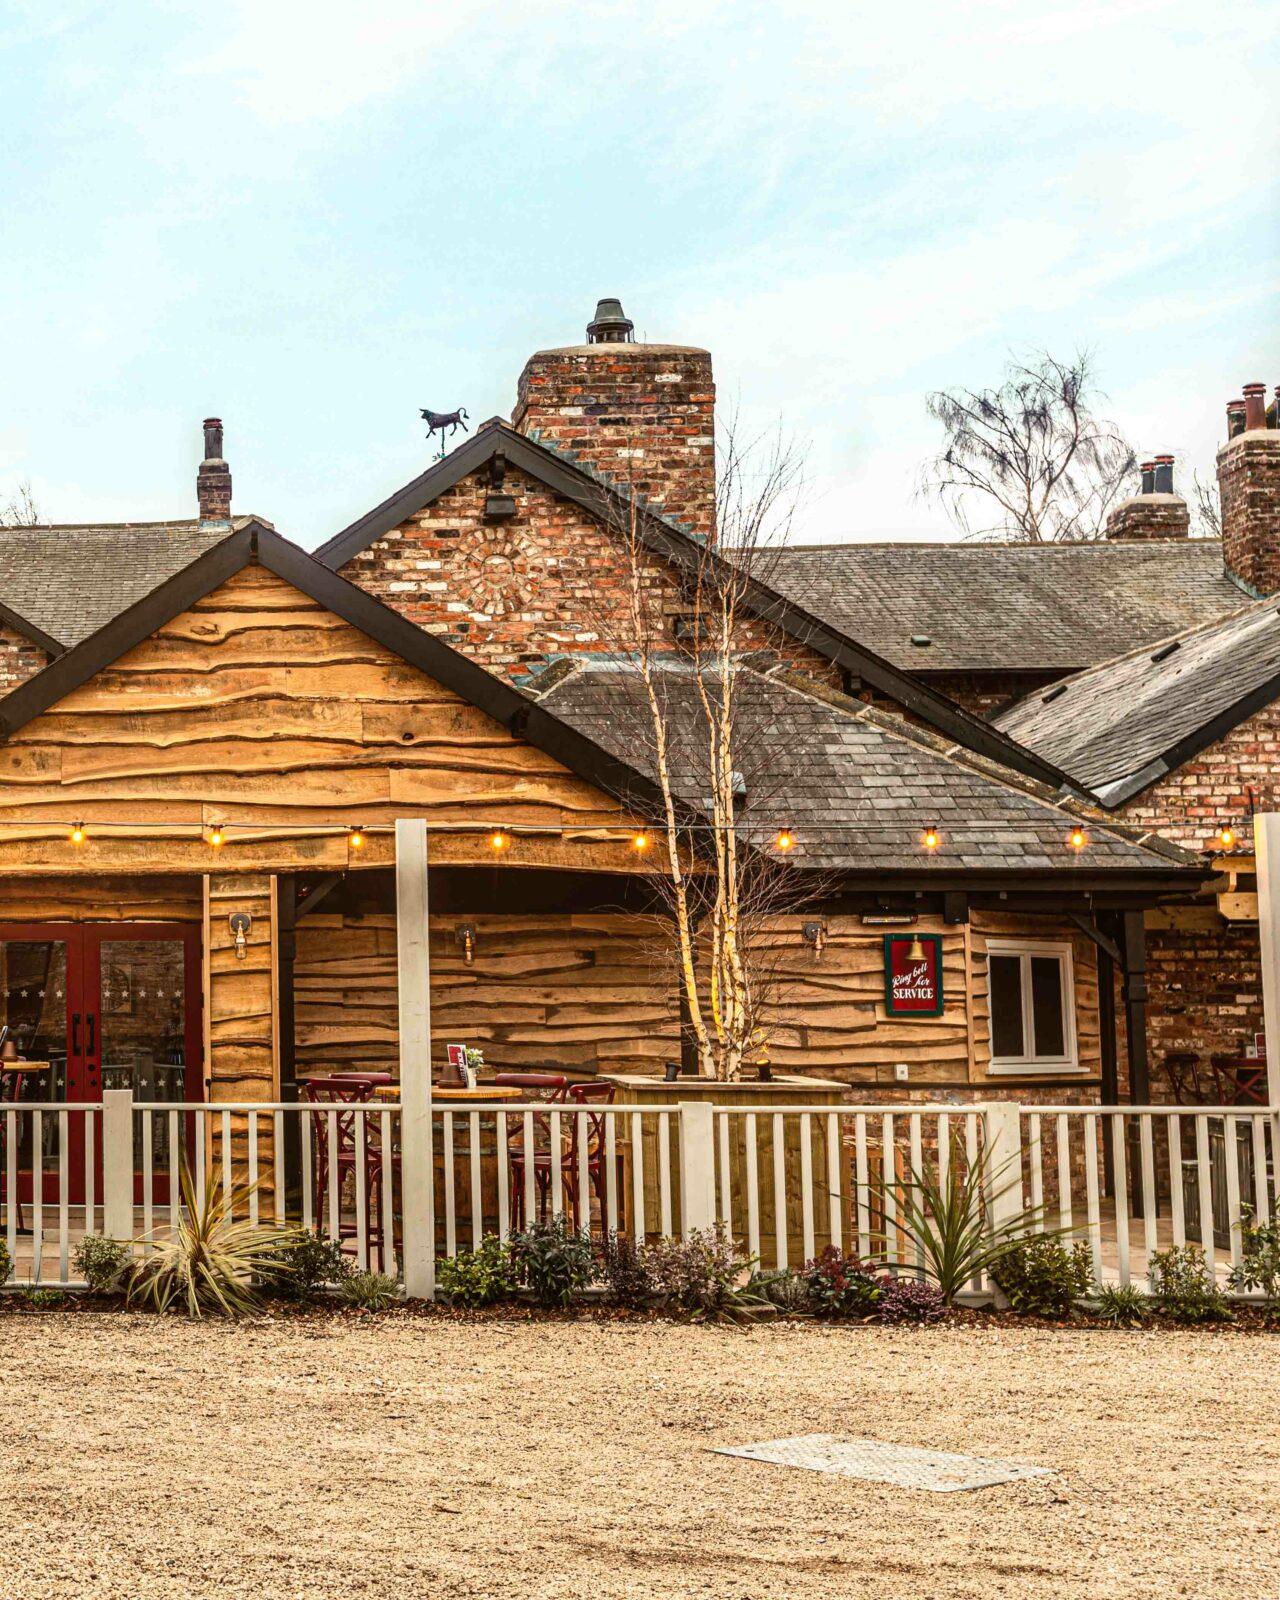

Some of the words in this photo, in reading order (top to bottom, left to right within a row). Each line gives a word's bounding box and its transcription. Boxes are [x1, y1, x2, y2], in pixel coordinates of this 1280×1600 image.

[892, 972, 912, 988] Ring
[912, 962, 928, 977] bell
[911, 975, 930, 988] for
[893, 988, 934, 999] SERVICE
